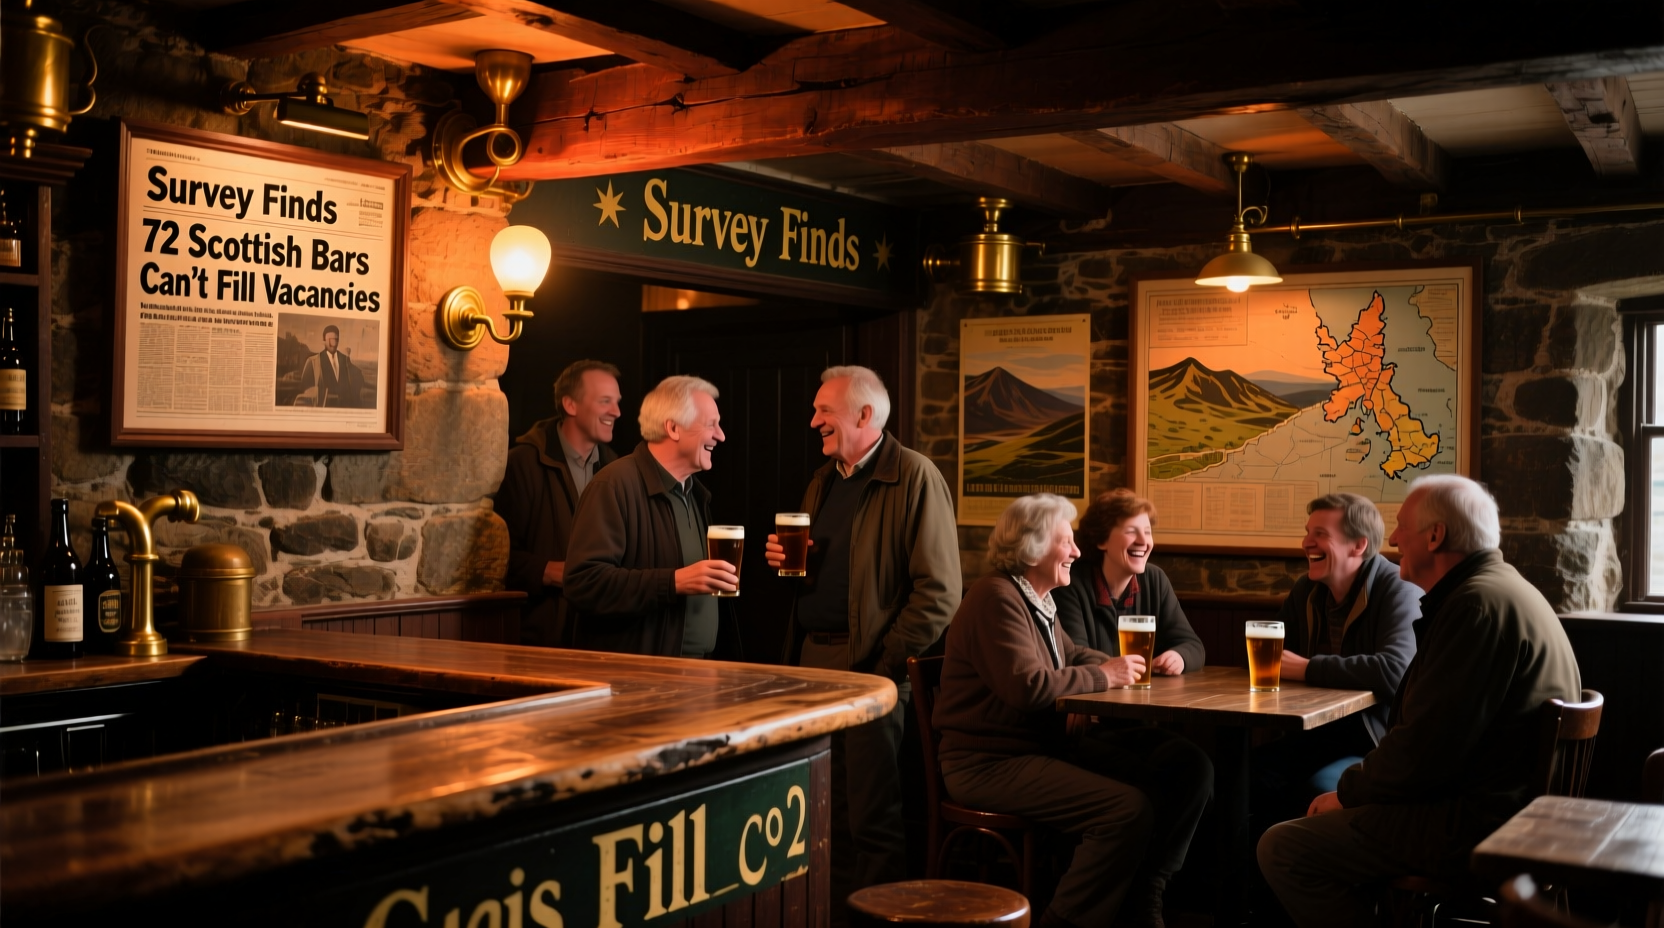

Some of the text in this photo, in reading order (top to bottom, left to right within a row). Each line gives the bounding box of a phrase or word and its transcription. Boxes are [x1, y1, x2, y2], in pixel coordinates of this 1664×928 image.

[147, 165, 254, 219] Survey
[262, 183, 338, 225] Finds
[643, 178, 859, 271] Survey Finds
[142, 217, 370, 276] 72 Scottish Bars
[139, 261, 380, 313] Can't Fill Vacancies
